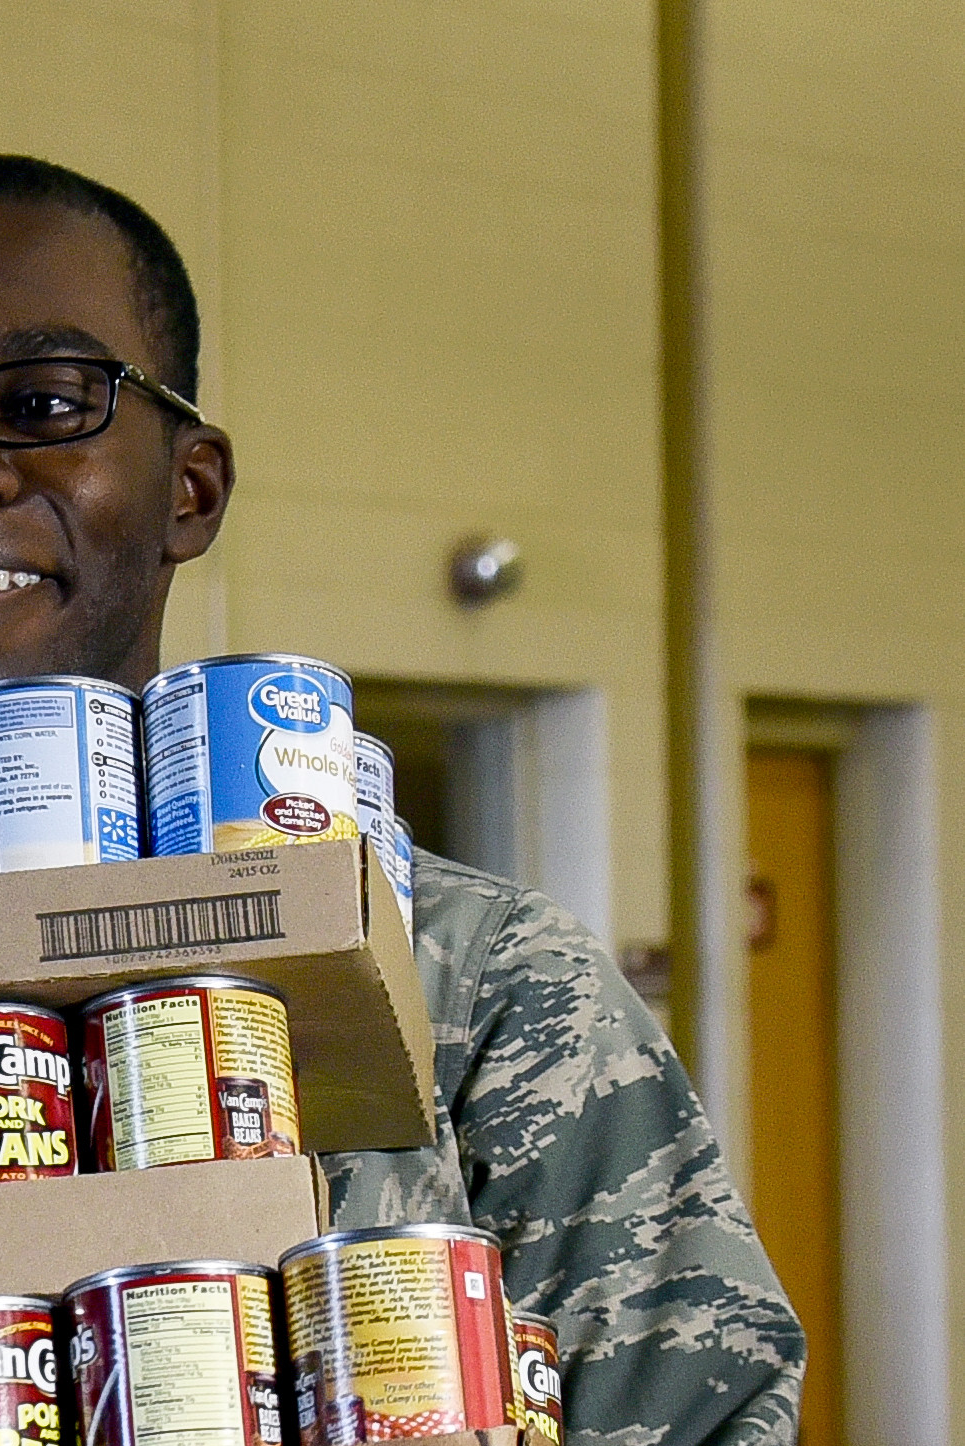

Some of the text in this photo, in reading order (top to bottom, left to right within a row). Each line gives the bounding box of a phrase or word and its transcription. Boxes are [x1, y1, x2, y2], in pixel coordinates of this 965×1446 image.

[260, 685, 321, 712] Great
[276, 705, 322, 725] Value
[274, 746, 339, 777] Whole
[370, 818, 383, 836] 45
[259, 863, 281, 876] OZ
[105, 999, 198, 1024] Nutrition Facts
[218, 1091, 268, 1112] Van Camp's
[232, 1112, 261, 1128] BAKED
[126, 1284, 228, 1300] Nutrition Facts
[518, 1350, 562, 1404] Cam
